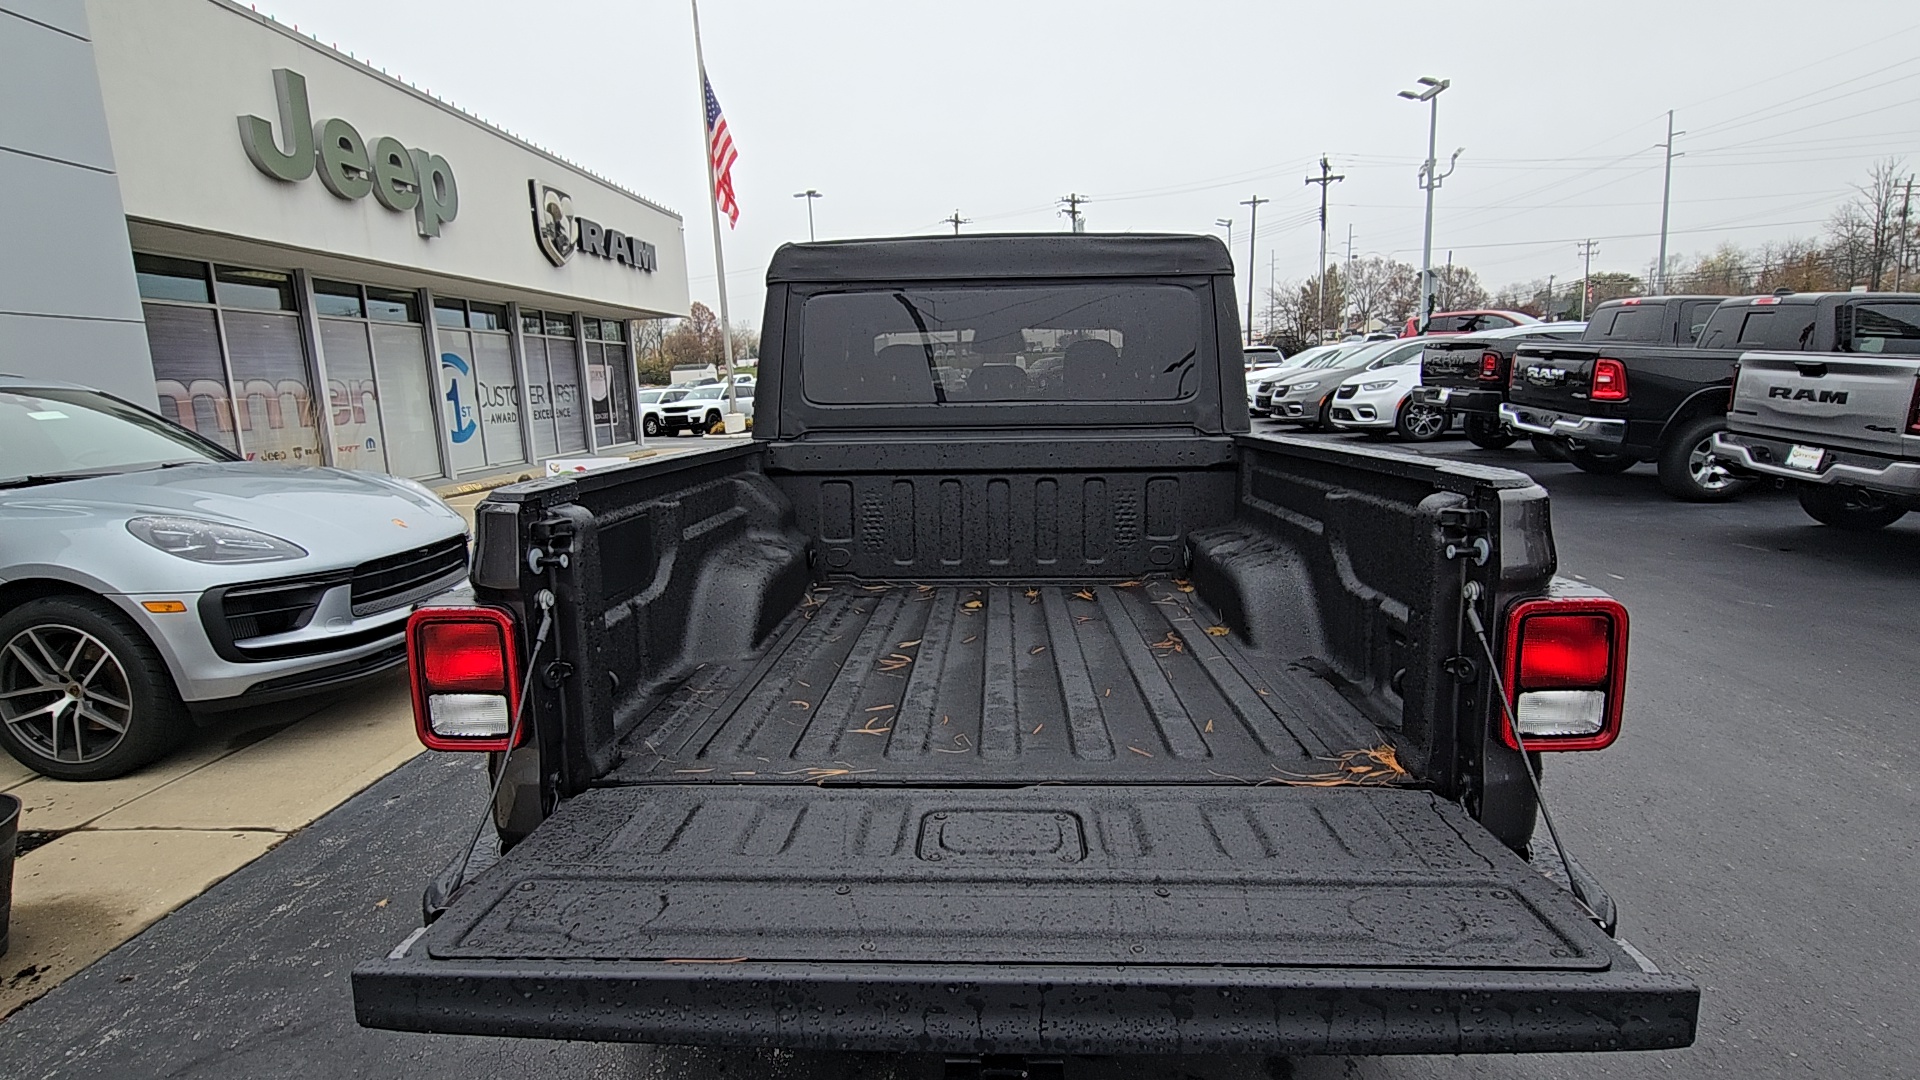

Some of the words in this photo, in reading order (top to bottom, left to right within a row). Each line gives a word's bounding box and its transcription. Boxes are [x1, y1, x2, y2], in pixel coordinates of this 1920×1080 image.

[237, 68, 458, 237] Jeep
[575, 217, 658, 272] RAM
[1527, 367, 1566, 381] RAM
[475, 382, 545, 408] CUSTOER
[1769, 386, 1849, 405] RAM
[490, 412, 517, 424] AWARD
